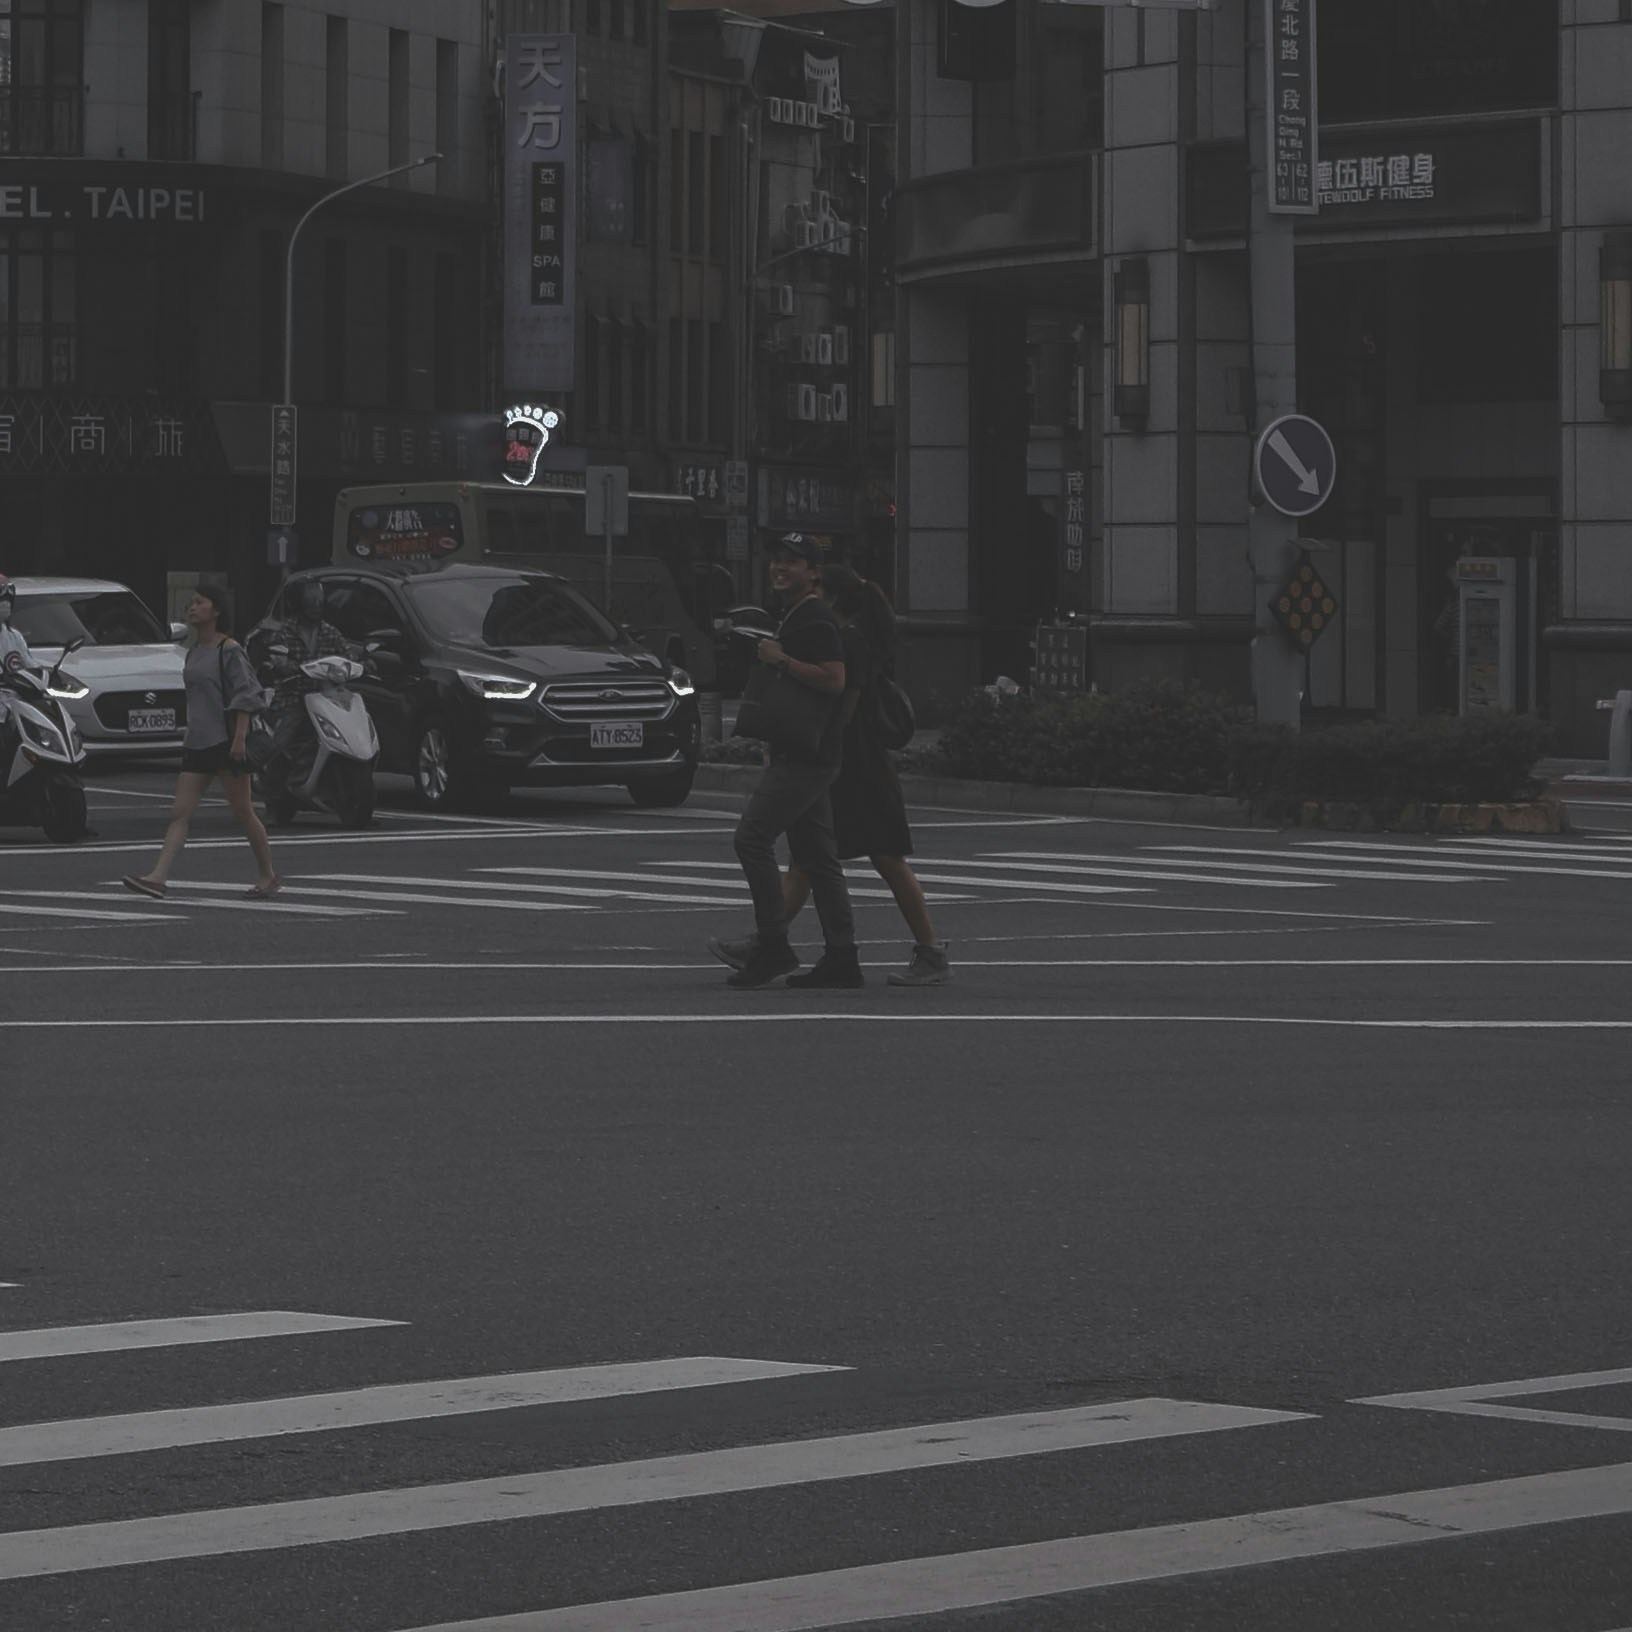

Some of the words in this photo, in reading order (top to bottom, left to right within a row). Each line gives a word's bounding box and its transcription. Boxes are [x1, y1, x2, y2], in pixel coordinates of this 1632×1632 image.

[518, 40, 564, 152] 天方
[83, 187, 205, 222] TAIPEI
[1380, 185, 1434, 200] FITNESS
